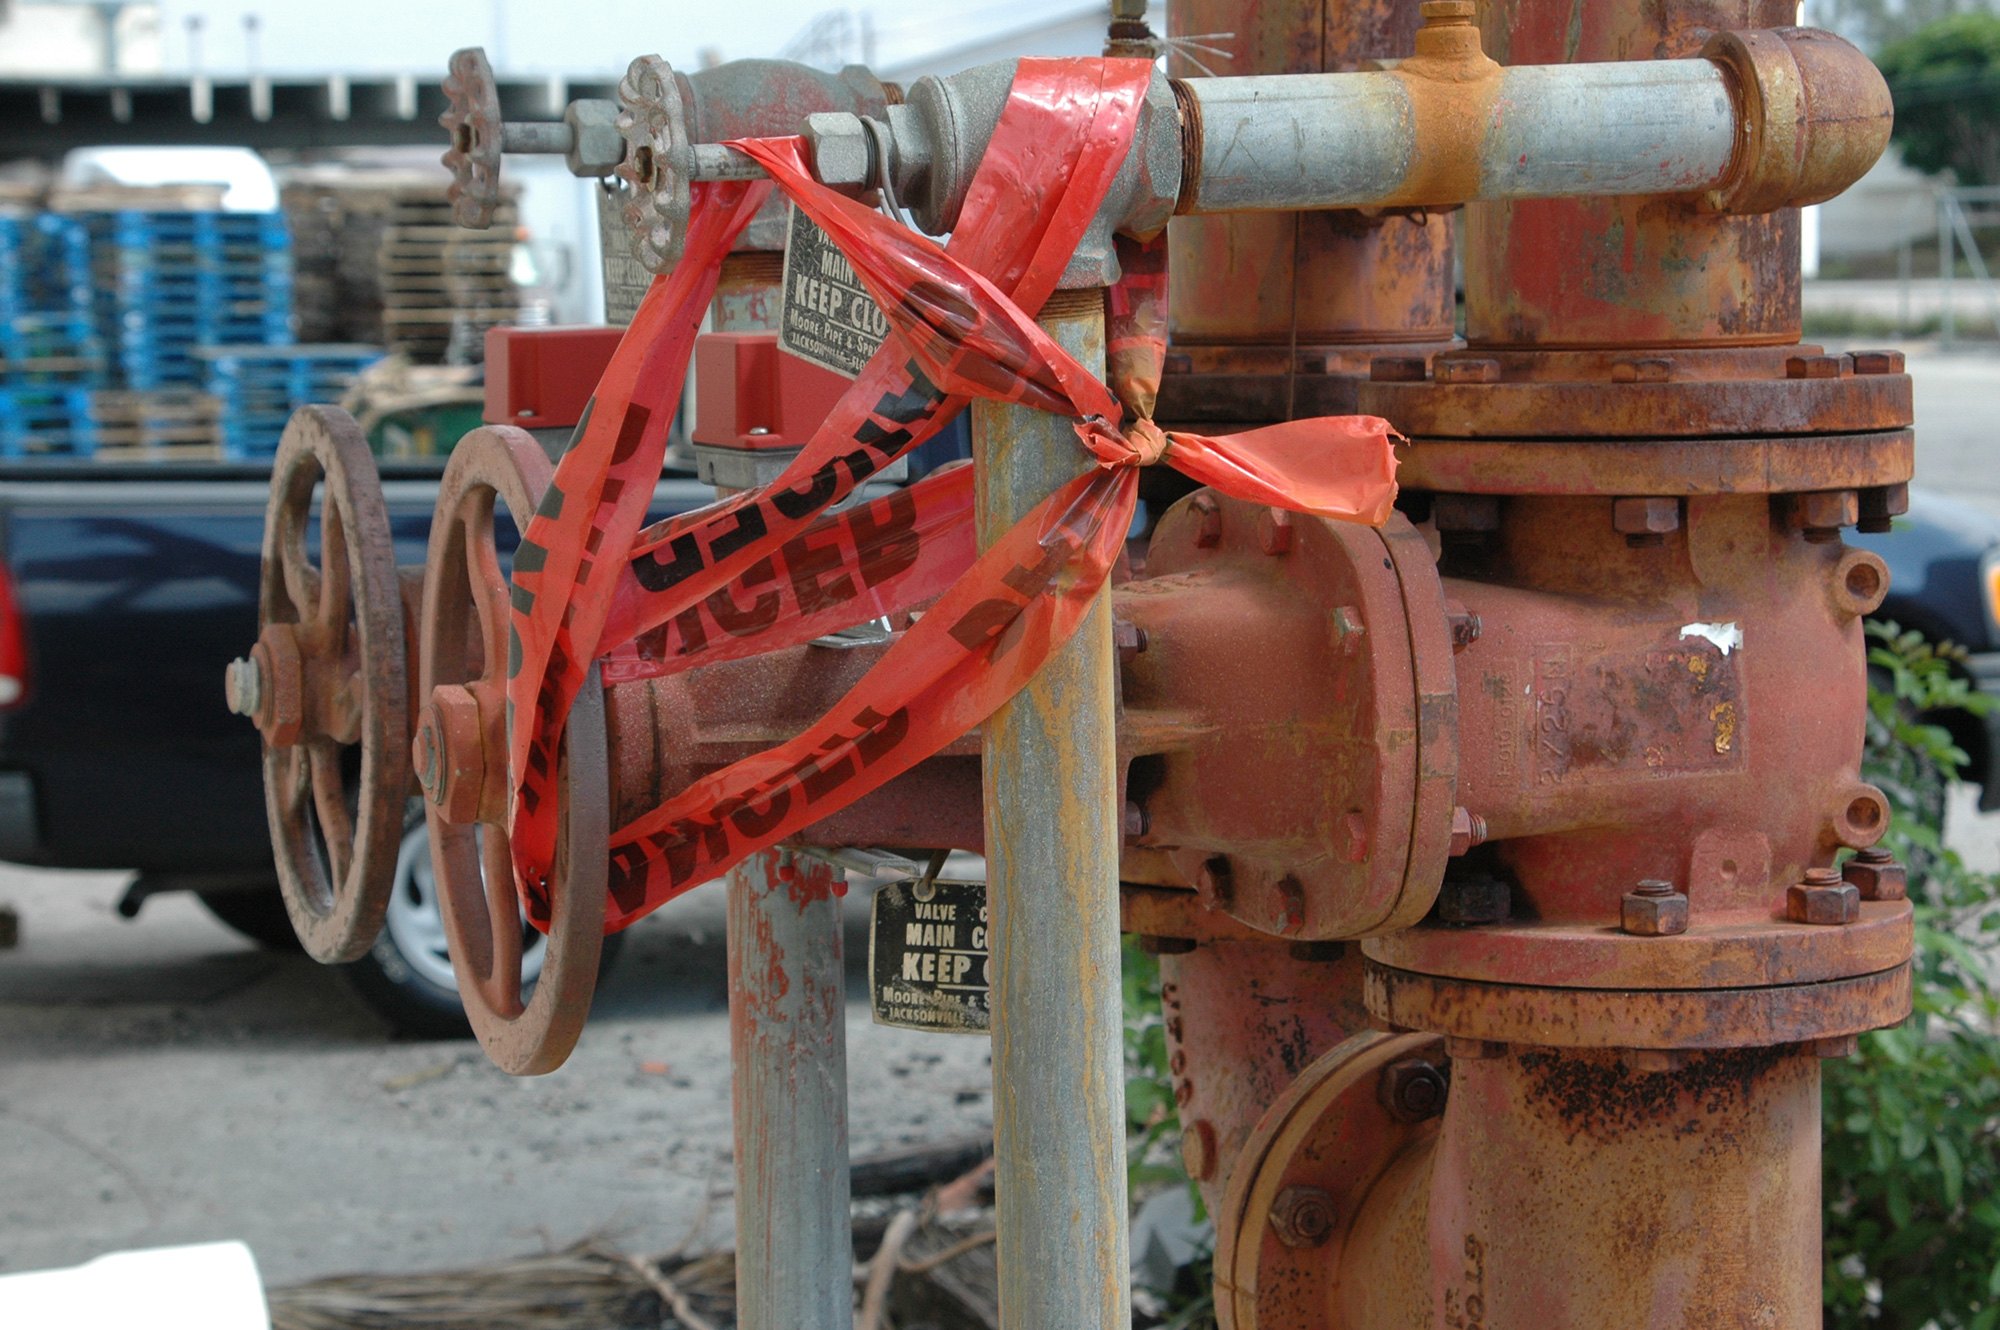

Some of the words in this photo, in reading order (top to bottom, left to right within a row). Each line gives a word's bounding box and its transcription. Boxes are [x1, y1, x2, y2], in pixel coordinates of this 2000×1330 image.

[821, 250, 854, 285] MAIN
[795, 273, 842, 318] KEEP
[851, 296, 887, 337] CLO
[790, 308, 820, 335] MOORE
[824, 322, 843, 345] PIPE
[914, 903, 957, 921] VALVE
[905, 923, 955, 947] MAIN
[902, 952, 971, 983] KEEP
[883, 986, 926, 1005] MOORE
[968, 995, 977, 1007] &
